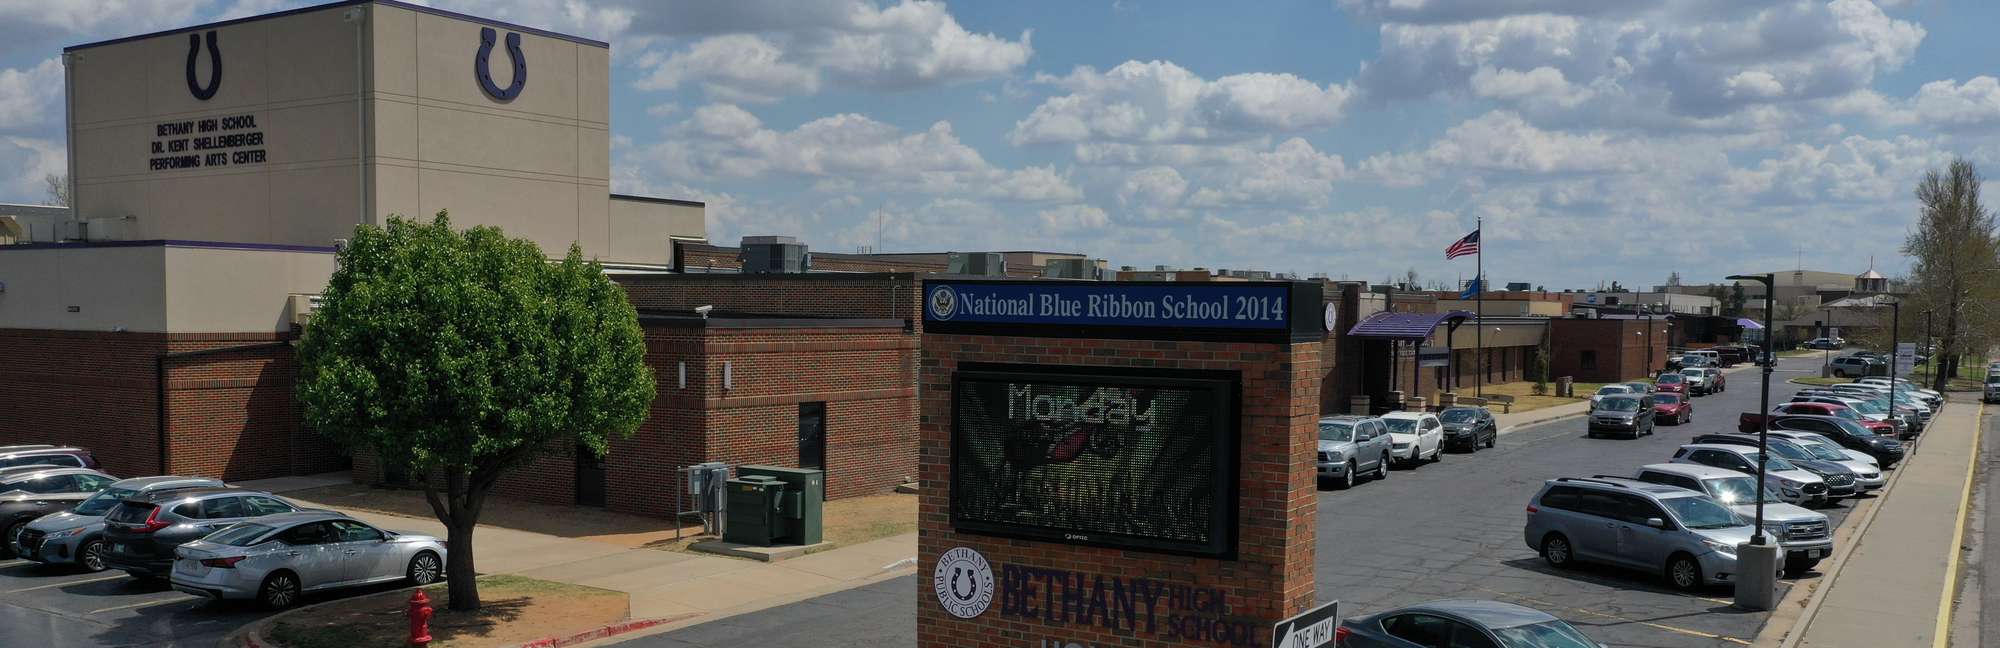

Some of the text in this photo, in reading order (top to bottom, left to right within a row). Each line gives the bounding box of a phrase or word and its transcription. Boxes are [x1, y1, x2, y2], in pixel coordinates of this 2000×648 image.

[157, 115, 256, 137] BETHANY HIGH SCHOOL
[152, 132, 264, 154] DR. KENT SHELLENBERGER
[150, 149, 266, 171] PERFORMING ARTS CENTER
[960, 293, 1283, 321] National Blue Ribbon School 2014
[1008, 383, 1155, 432] Monday
[941, 549, 987, 571] BETHANY
[936, 576, 993, 617] PUBLIC SCHOOLS
[1002, 563, 1167, 636] BETHANY
[1170, 586, 1226, 617] HIGH
[1168, 616, 1258, 648] SCHOOL
[1293, 620, 1330, 648] ONE WAY
